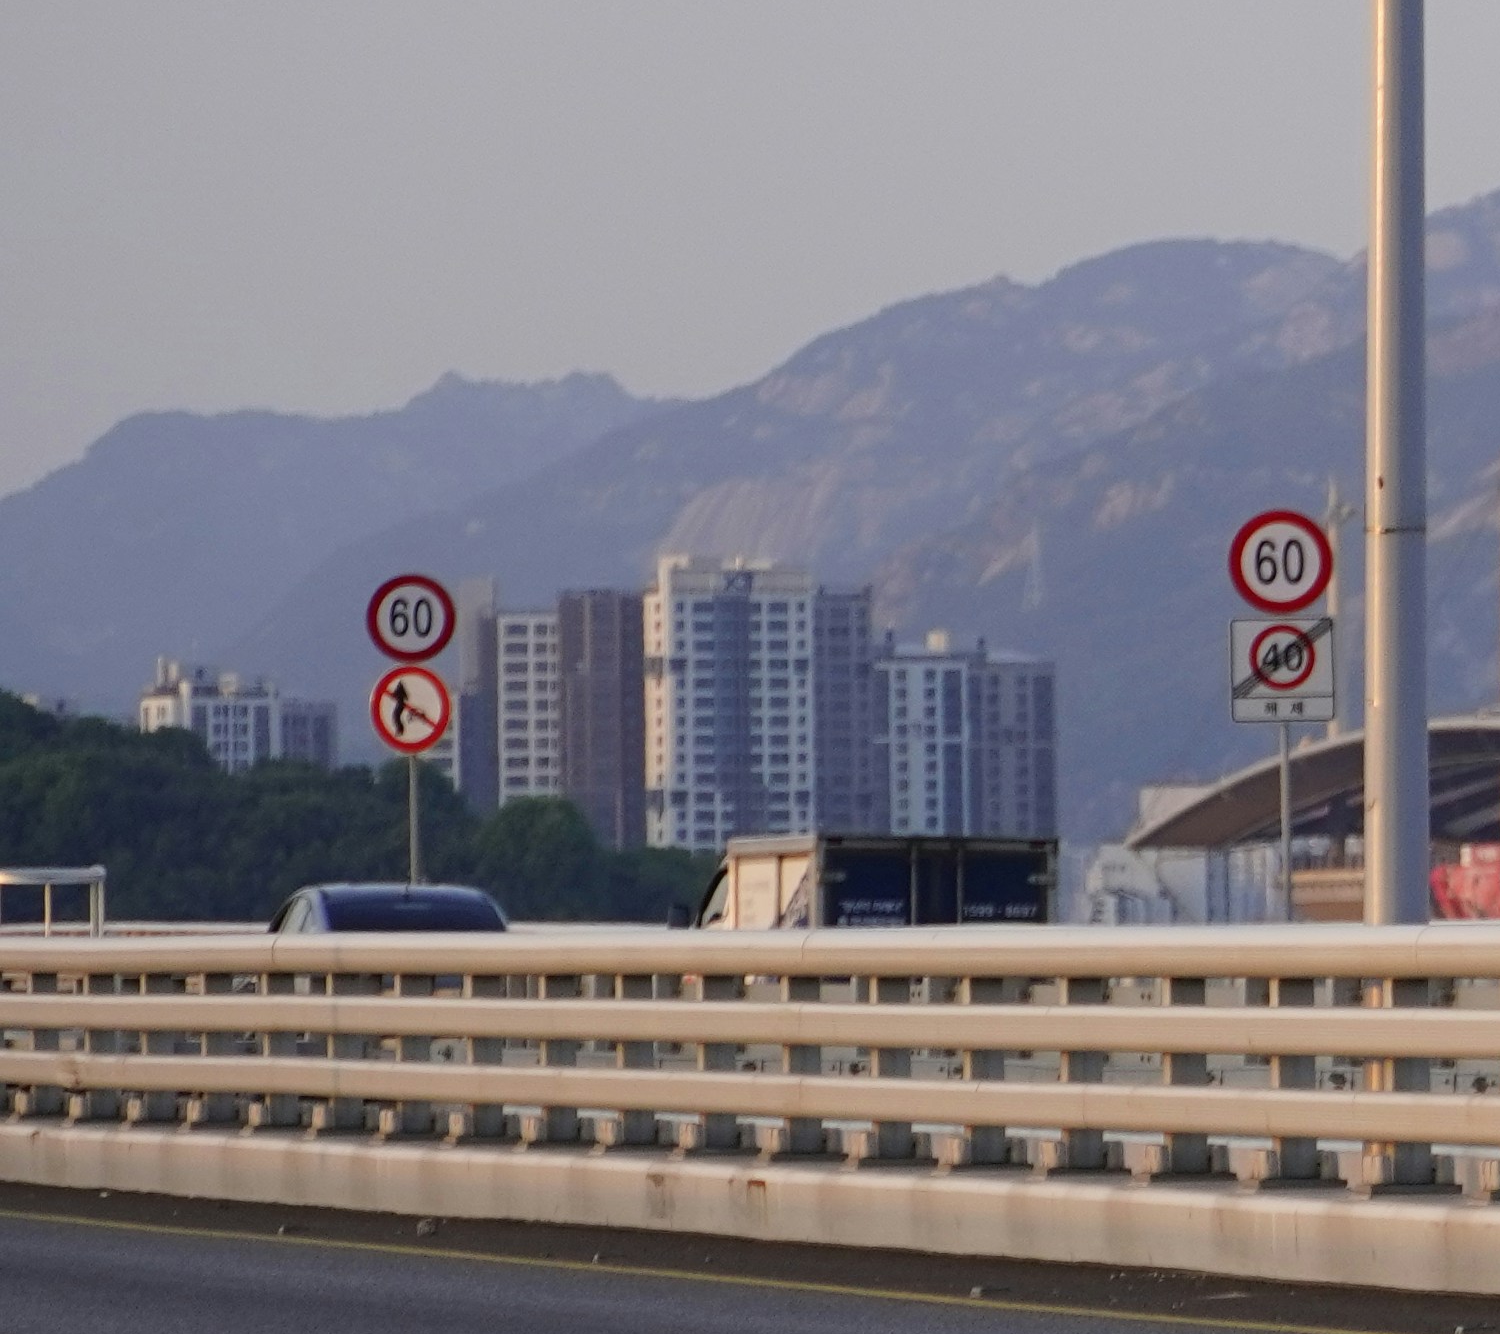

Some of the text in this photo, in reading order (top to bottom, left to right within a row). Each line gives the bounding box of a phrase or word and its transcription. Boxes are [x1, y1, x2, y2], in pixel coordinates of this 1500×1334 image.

[1256, 539, 1304, 584] 60
[390, 598, 432, 638] 60
[1262, 643, 1303, 671] 40
